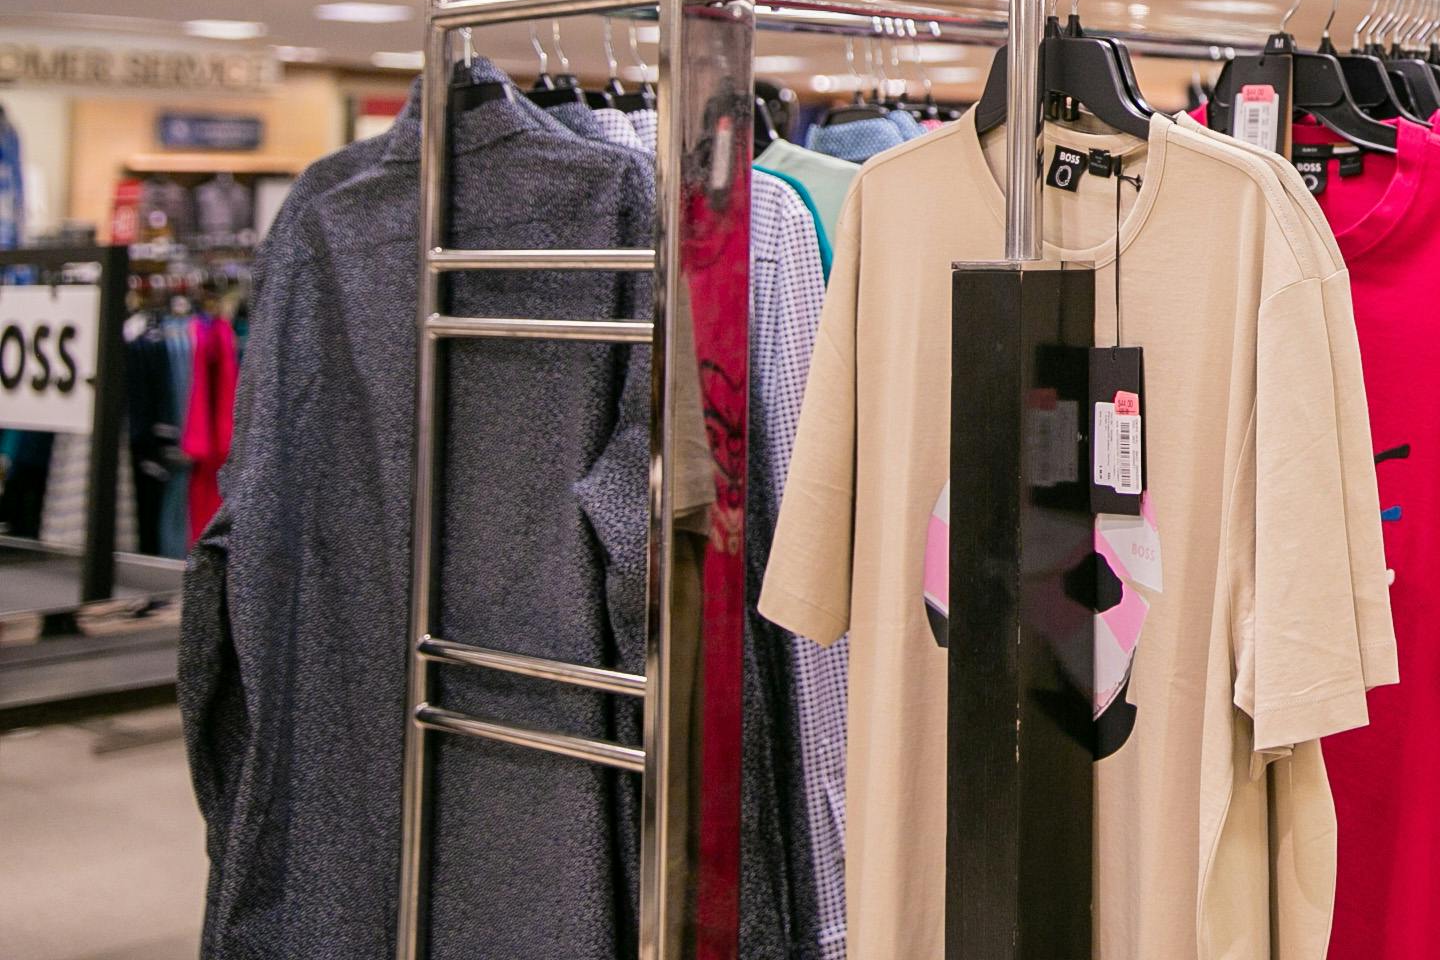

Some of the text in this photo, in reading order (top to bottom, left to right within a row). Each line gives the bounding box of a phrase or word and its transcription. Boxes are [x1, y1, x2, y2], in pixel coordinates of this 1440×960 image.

[1273, 38, 1285, 49] M
[1059, 151, 1081, 165] BOSS
[1296, 162, 1322, 173] BOSS
